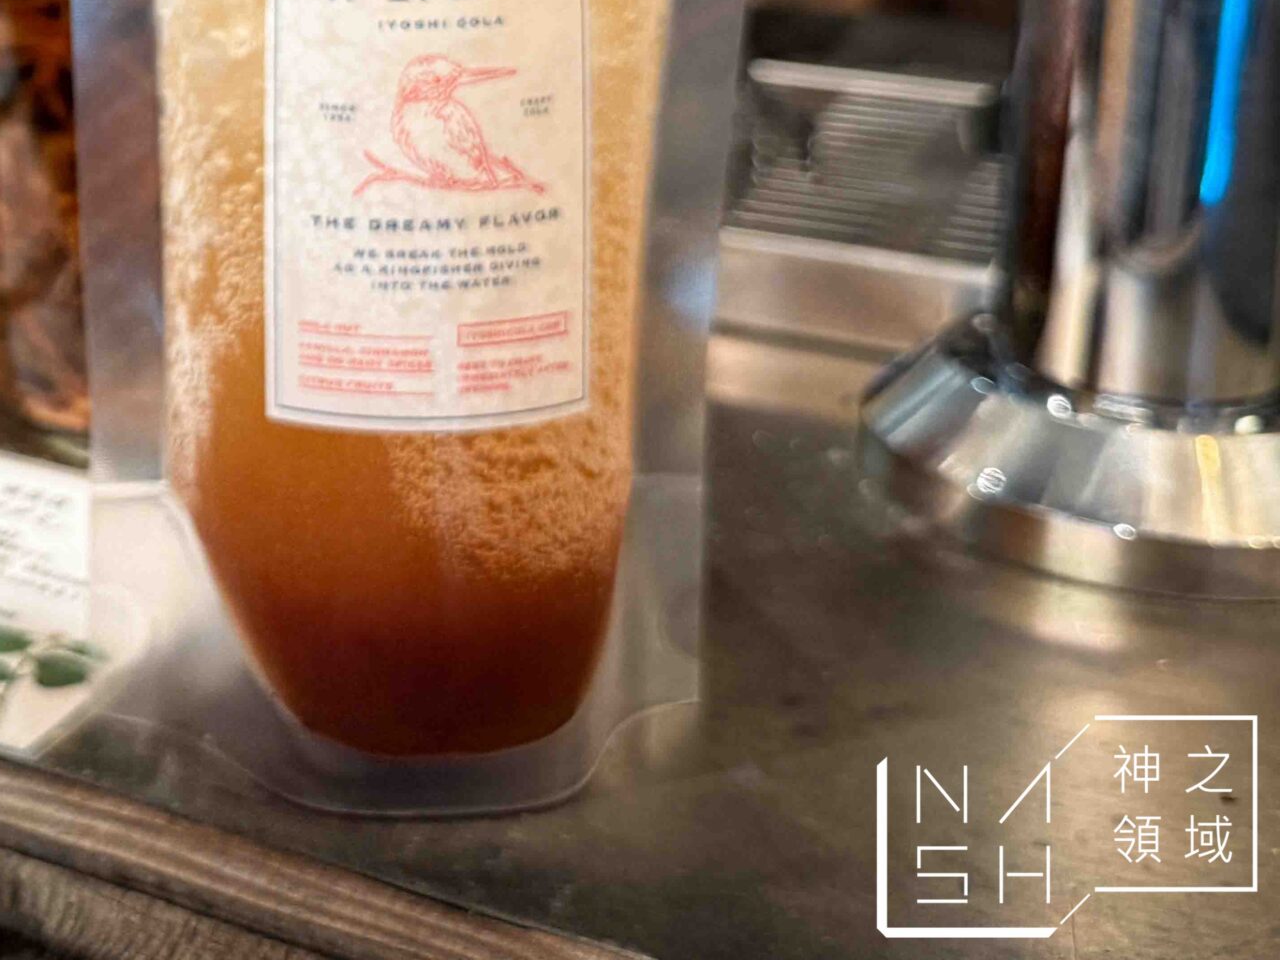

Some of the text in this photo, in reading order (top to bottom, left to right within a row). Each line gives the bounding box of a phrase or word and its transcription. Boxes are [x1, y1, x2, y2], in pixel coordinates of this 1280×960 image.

[310, 208, 562, 233] THE DREAMY FLAVOR
